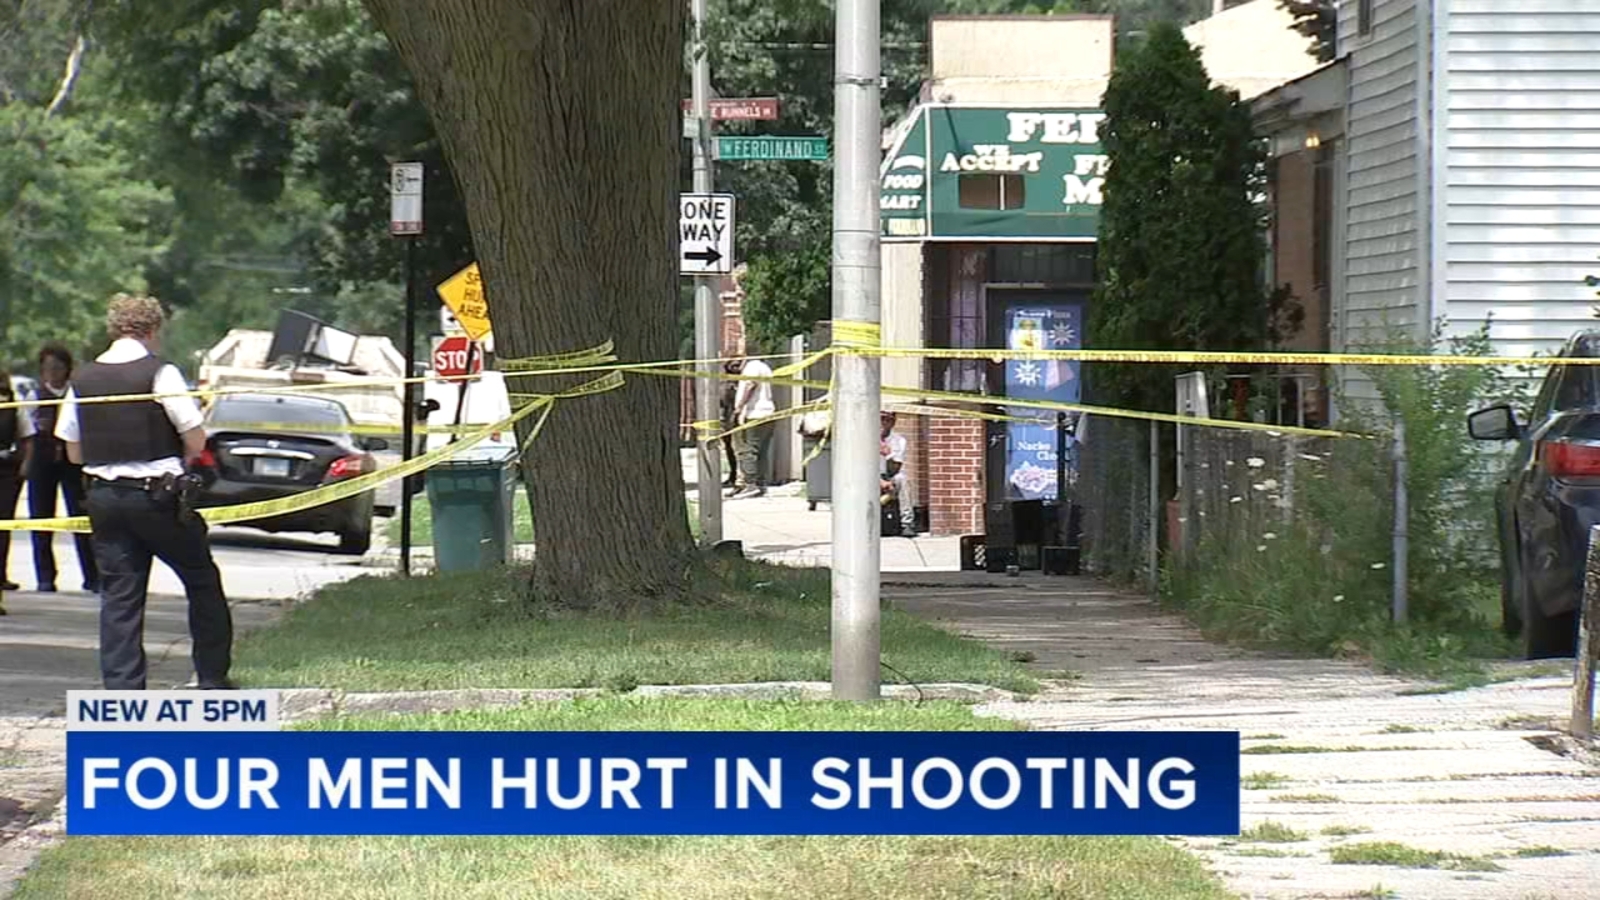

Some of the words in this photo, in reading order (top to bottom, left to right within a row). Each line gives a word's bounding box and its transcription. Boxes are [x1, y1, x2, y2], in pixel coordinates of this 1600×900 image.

[734, 140, 812, 158] FERDINAND
[973, 145, 1009, 156] WE
[940, 152, 1043, 171] ACCEPT
[883, 174, 923, 189] FOOD
[684, 201, 726, 220] ONE
[683, 224, 726, 241] WAY
